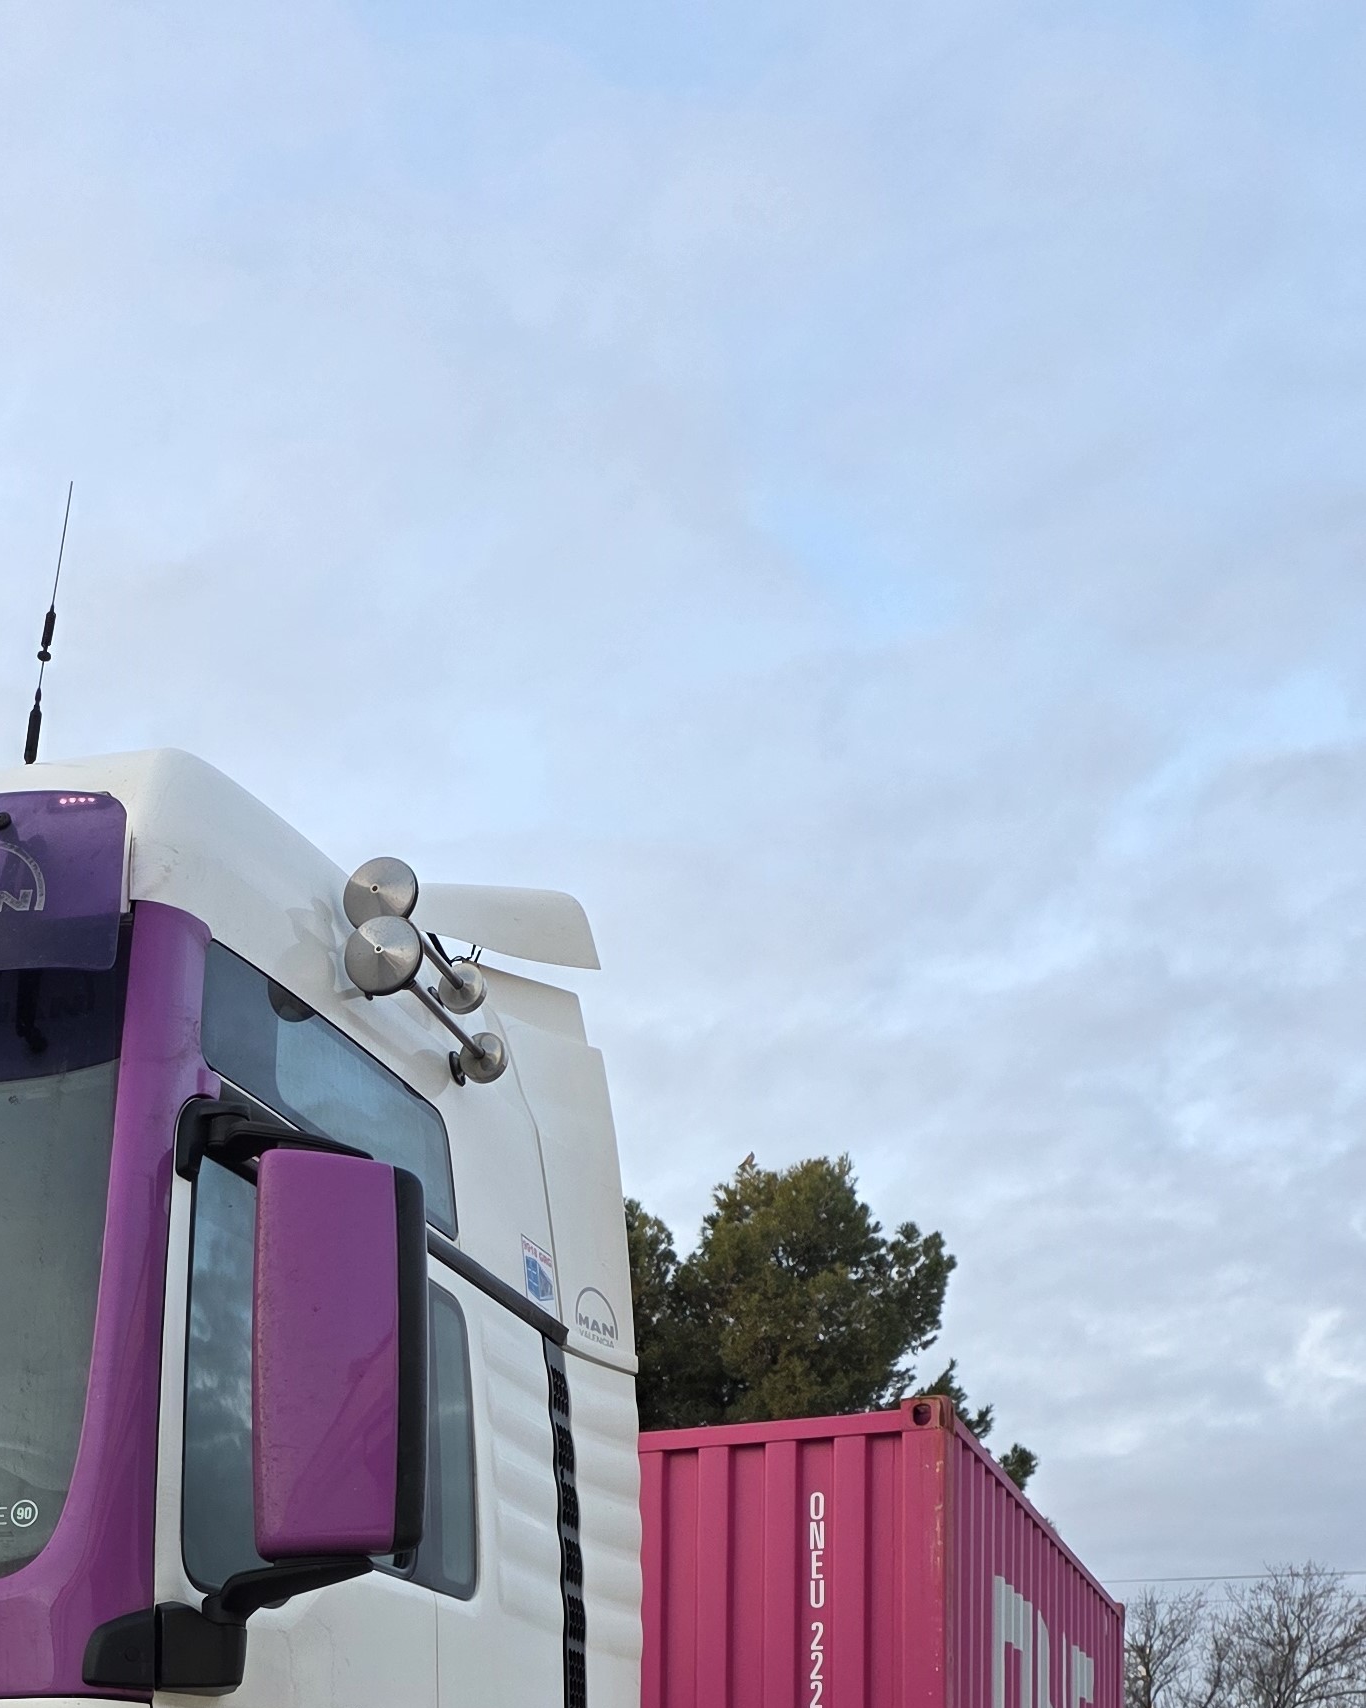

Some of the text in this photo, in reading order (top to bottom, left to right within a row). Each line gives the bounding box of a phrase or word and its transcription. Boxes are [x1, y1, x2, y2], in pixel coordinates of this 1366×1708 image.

[578, 1313, 615, 1339] MAN
[579, 1328, 615, 1349] VALENCIA
[16, 1506, 33, 1520] 90
[809, 1491, 825, 1609] ONEU
